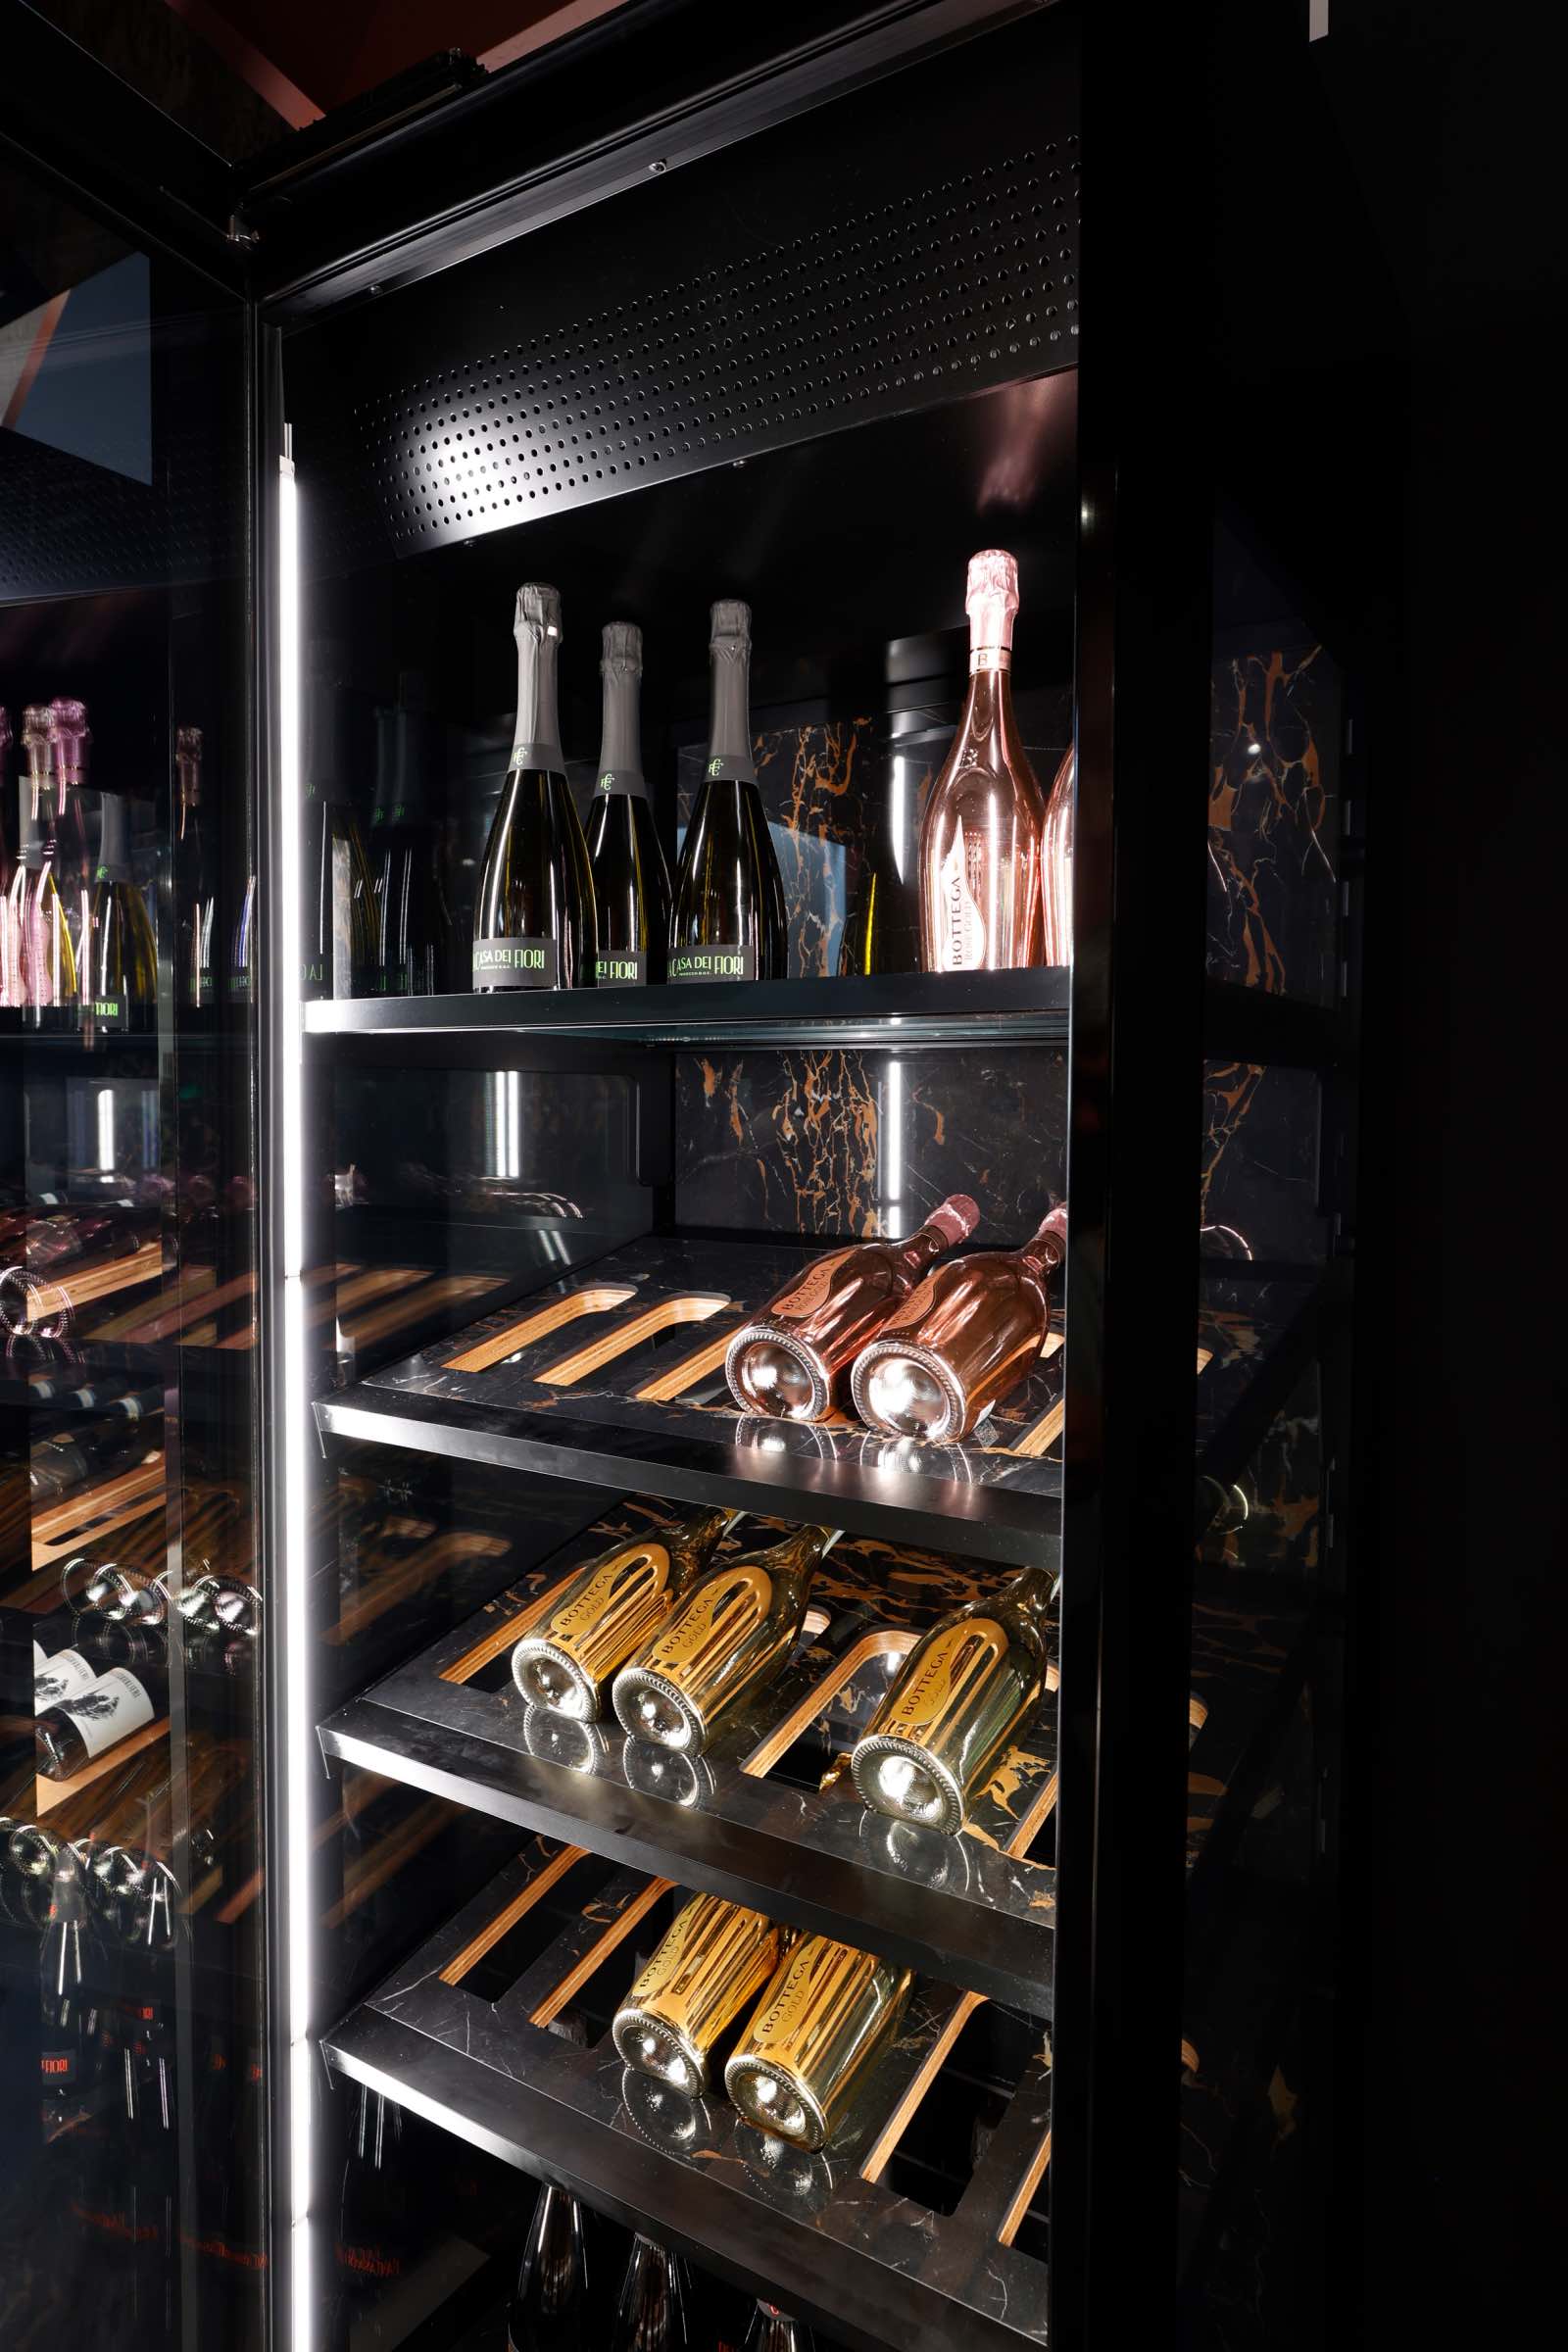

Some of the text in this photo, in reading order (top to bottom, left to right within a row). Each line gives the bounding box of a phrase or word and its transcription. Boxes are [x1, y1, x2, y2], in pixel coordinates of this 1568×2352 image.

[951, 877, 962, 965] BOTTEGA
[494, 949, 511, 963] DEI
[514, 949, 545, 969] FIORI
[596, 960, 638, 980] EI FIORI
[694, 956, 711, 970] DEI
[714, 956, 744, 975] FIORI
[781, 1268, 831, 1310] BOTTEGA
[560, 1575, 612, 1626] BOTTEGA
[662, 1599, 713, 1654] BOTTEGA
[902, 1652, 949, 1716] BOTTEGA
[639, 1920, 688, 1987] BOTTEGA
[762, 1960, 809, 2034] BOTTEGA
[782, 1990, 804, 2022] GOLD
